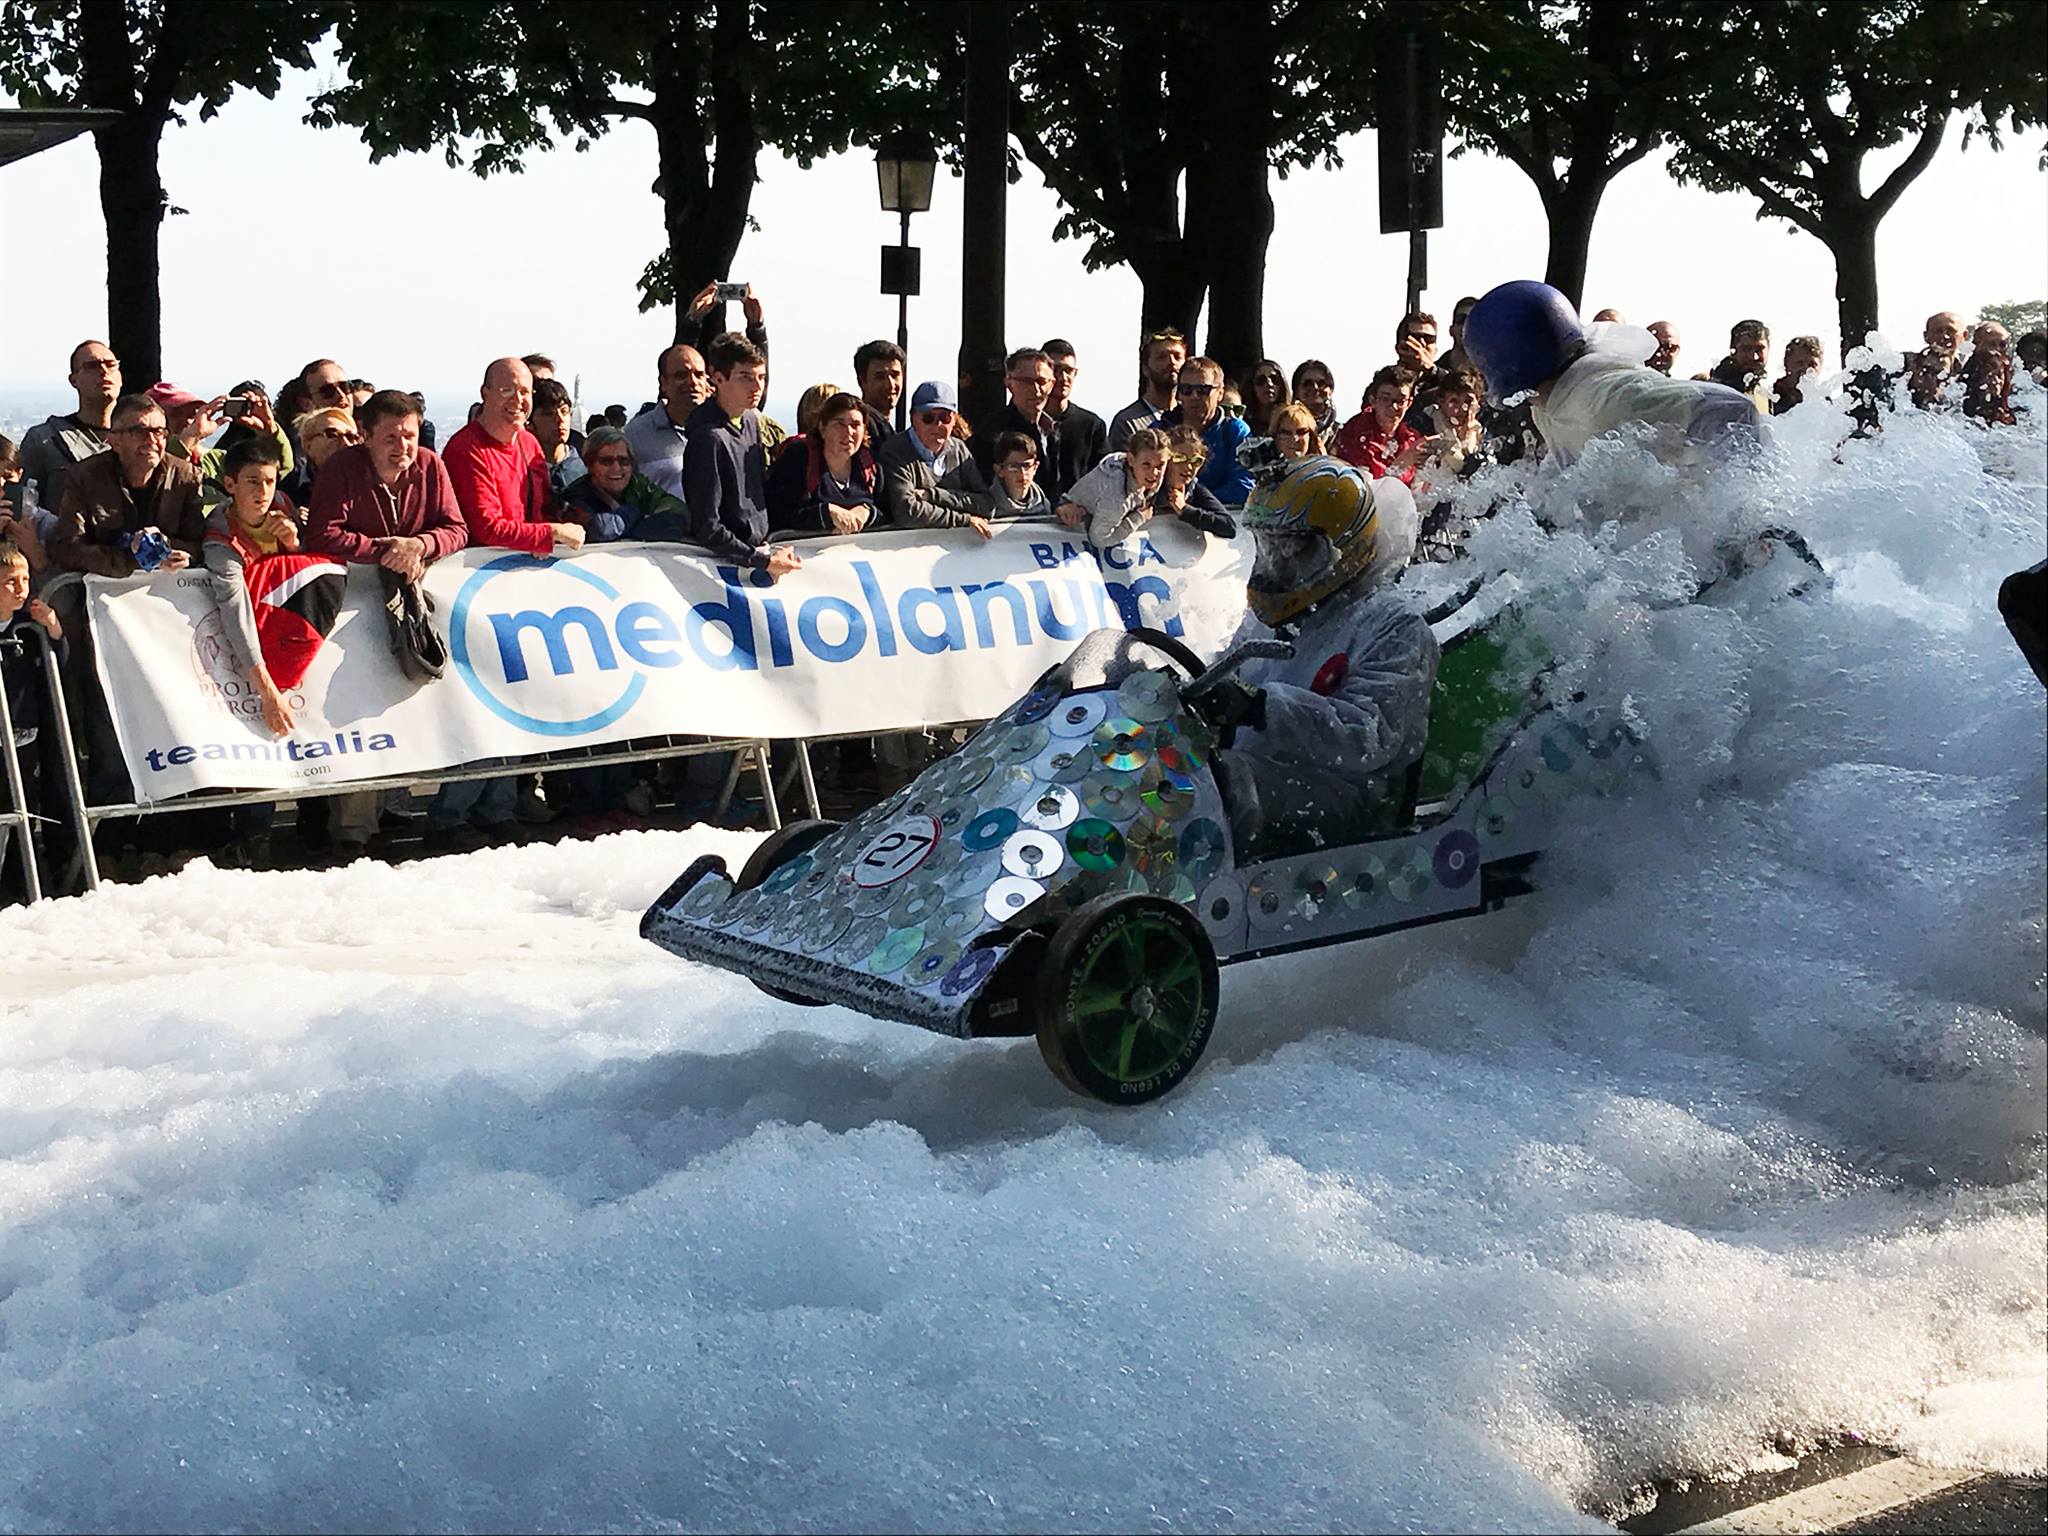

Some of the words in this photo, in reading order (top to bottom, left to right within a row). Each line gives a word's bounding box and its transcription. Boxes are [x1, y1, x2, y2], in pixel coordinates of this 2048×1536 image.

[487, 560, 1185, 684] mediolanum
[199, 681, 240, 697] PRO
[145, 730, 397, 773] teamitalia
[863, 832, 933, 869] 27
